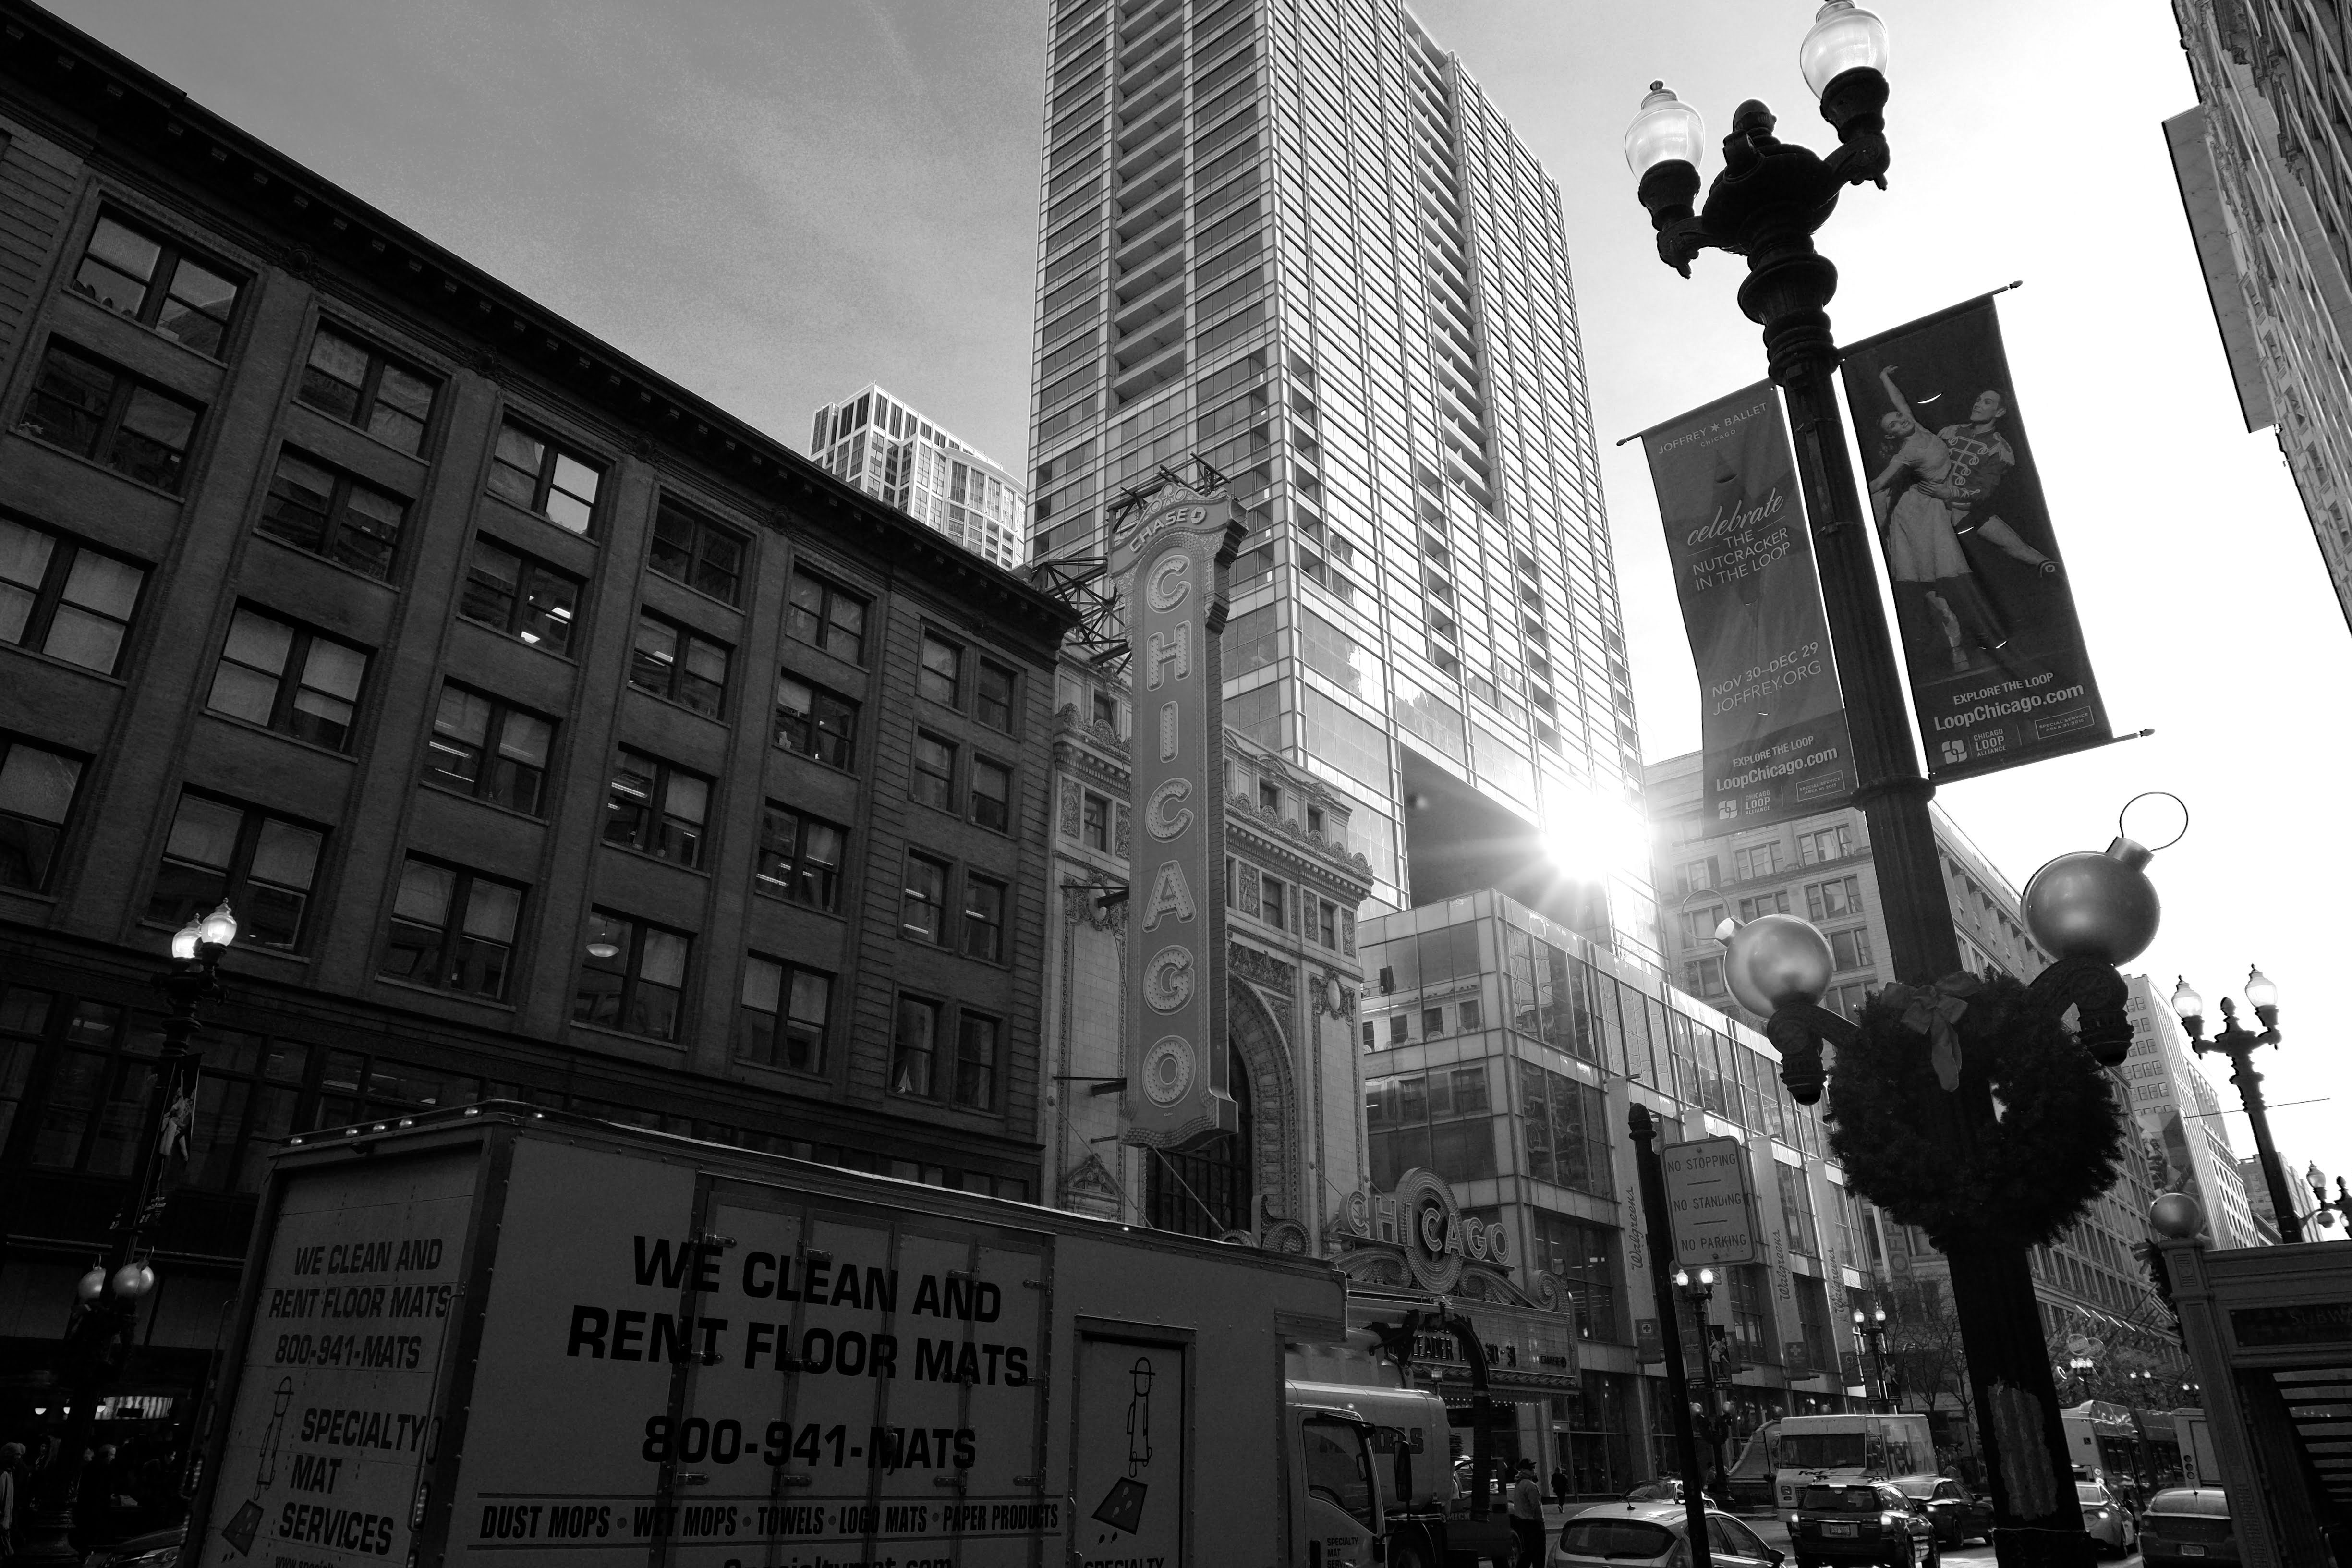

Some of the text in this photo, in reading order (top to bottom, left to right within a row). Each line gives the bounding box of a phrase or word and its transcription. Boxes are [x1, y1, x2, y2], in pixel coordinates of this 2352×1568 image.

[1659, 402, 1768, 454] JOFFREY BALLET
[1700, 429, 1736, 447] CHICAGO
[1129, 507, 1189, 553] CHASE
[1687, 487, 1784, 546] celebrate
[1692, 528, 1788, 576] NUTCRACKER
[1723, 530, 1755, 548] THE
[1695, 542, 1791, 591] IN THE LOOP
[1711, 675, 1743, 698] NOV
[1802, 642, 1819, 658] 29
[1713, 660, 1822, 716] JOFFREY.ORG
[1953, 672, 2054, 705] EXPLORE THE LOOP
[1934, 684, 2085, 731] LoopChicago.com
[2039, 712, 2089, 729] SPECIAL SERVICE
[1733, 736, 1815, 767] EXPLORE THE LOOP
[1973, 728, 2003, 741] CHICAGO
[1975, 735, 2005, 752] LOOP
[1976, 745, 2007, 757] ALLIANCE
[1716, 747, 1838, 792] LoopChicago.com
[1799, 777, 1841, 792] SPECIAL SERVICE
[1745, 790, 1770, 801] CHICAGO
[1745, 806, 1771, 815] ALLIANCE
[1746, 796, 1771, 810] LOOP
[1142, 554, 1196, 1108] CHICAGO
[1668, 1154, 1736, 1173] NO STOPPING
[1673, 1193, 1741, 1212] NO STANDING
[1341, 1191, 1511, 1264] CHICAGO
[1628, 1187, 1644, 1271] Walgreens
[1681, 1234, 1746, 1252] NO PARKING
[294, 1238, 443, 1275] WE CLEAN AND
[1772, 1229, 1792, 1301] Walgreens
[634, 1235, 1001, 1323] WE CLEAN AND
[1827, 1247, 1846, 1313] Walgreens
[269, 1285, 452, 1318] RENT FLOOR MATS
[274, 1334, 422, 1369] 800-941-MATS
[567, 1305, 1029, 1387] RENT FLOOR MATS
[301, 1408, 427, 1452] SPECIALTY
[642, 1416, 976, 1468] 800-941-MATS
[290, 1454, 342, 1494] MAT
[279, 1502, 394, 1555] SERVICES
[480, 1504, 1058, 1538] DUST MOPS WET MOPS TOWELS LOGO MATS PAPER PRODUCTS
[1327, 1536, 1358, 1546] SPECIALTY
[1327, 1548, 1341, 1557] MAT
